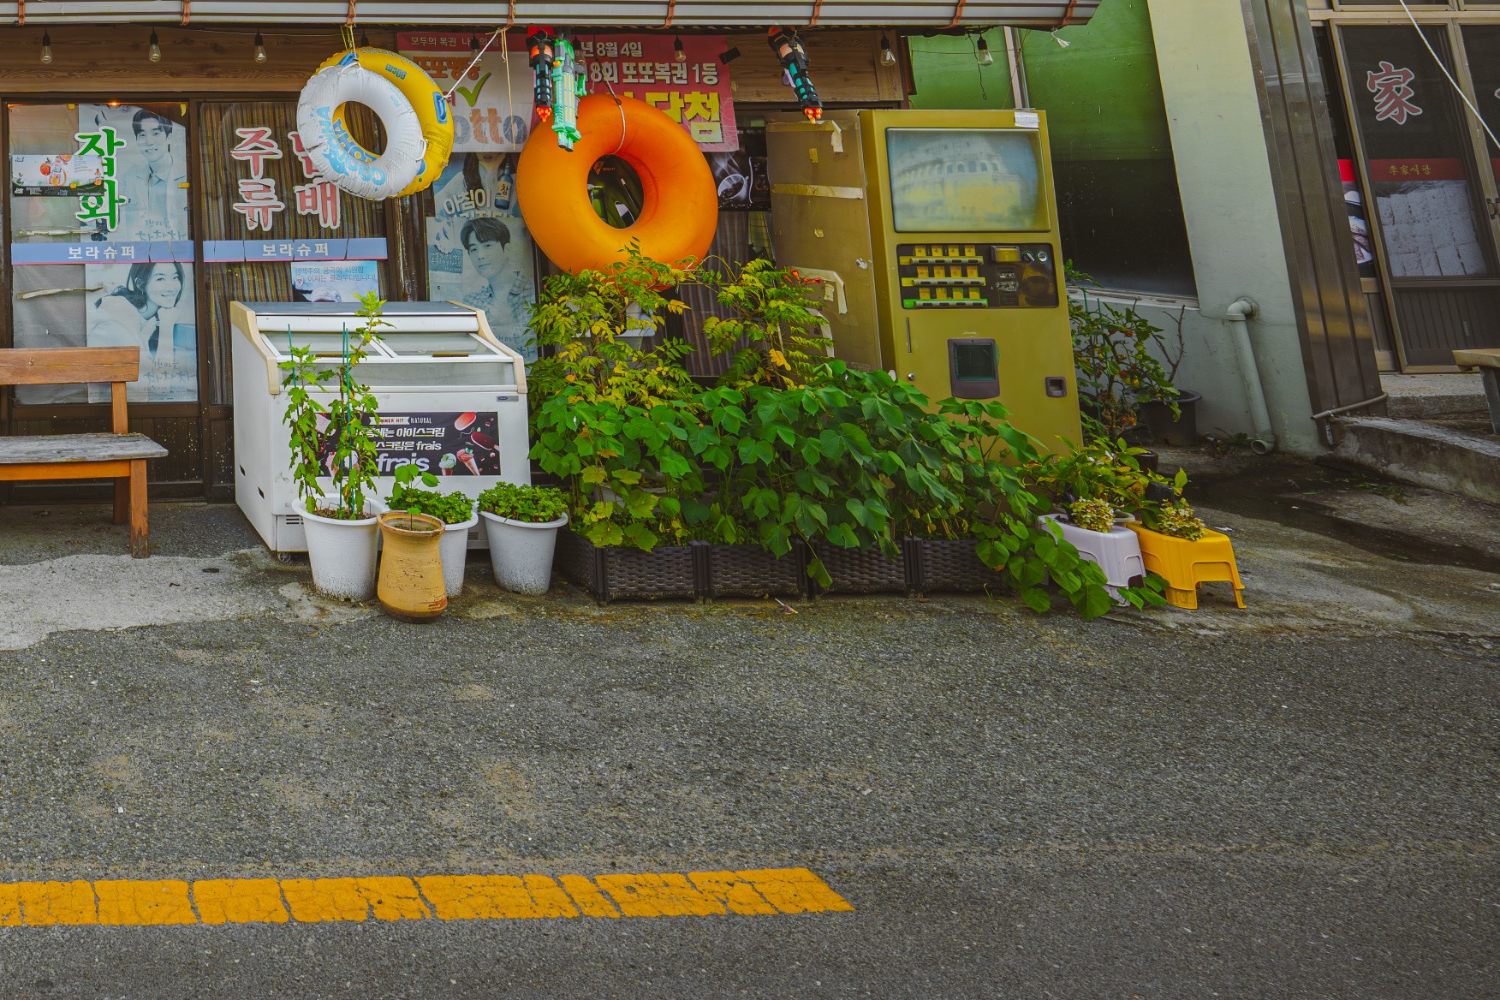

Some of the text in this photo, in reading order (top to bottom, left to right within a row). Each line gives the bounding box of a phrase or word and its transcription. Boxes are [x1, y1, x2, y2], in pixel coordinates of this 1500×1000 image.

[596, 42, 618, 58] 8월
[620, 41, 642, 58] 4일
[622, 62, 688, 85] 또또복권
[692, 62, 718, 85] 1등
[1367, 61, 1423, 125] 家
[231, 127, 285, 231] 주류
[68, 245, 135, 259] 보라슈퍼
[262, 243, 328, 257] 보라슈퍼
[396, 427, 446, 438] 아이스크림
[416, 440, 442, 451] frais
